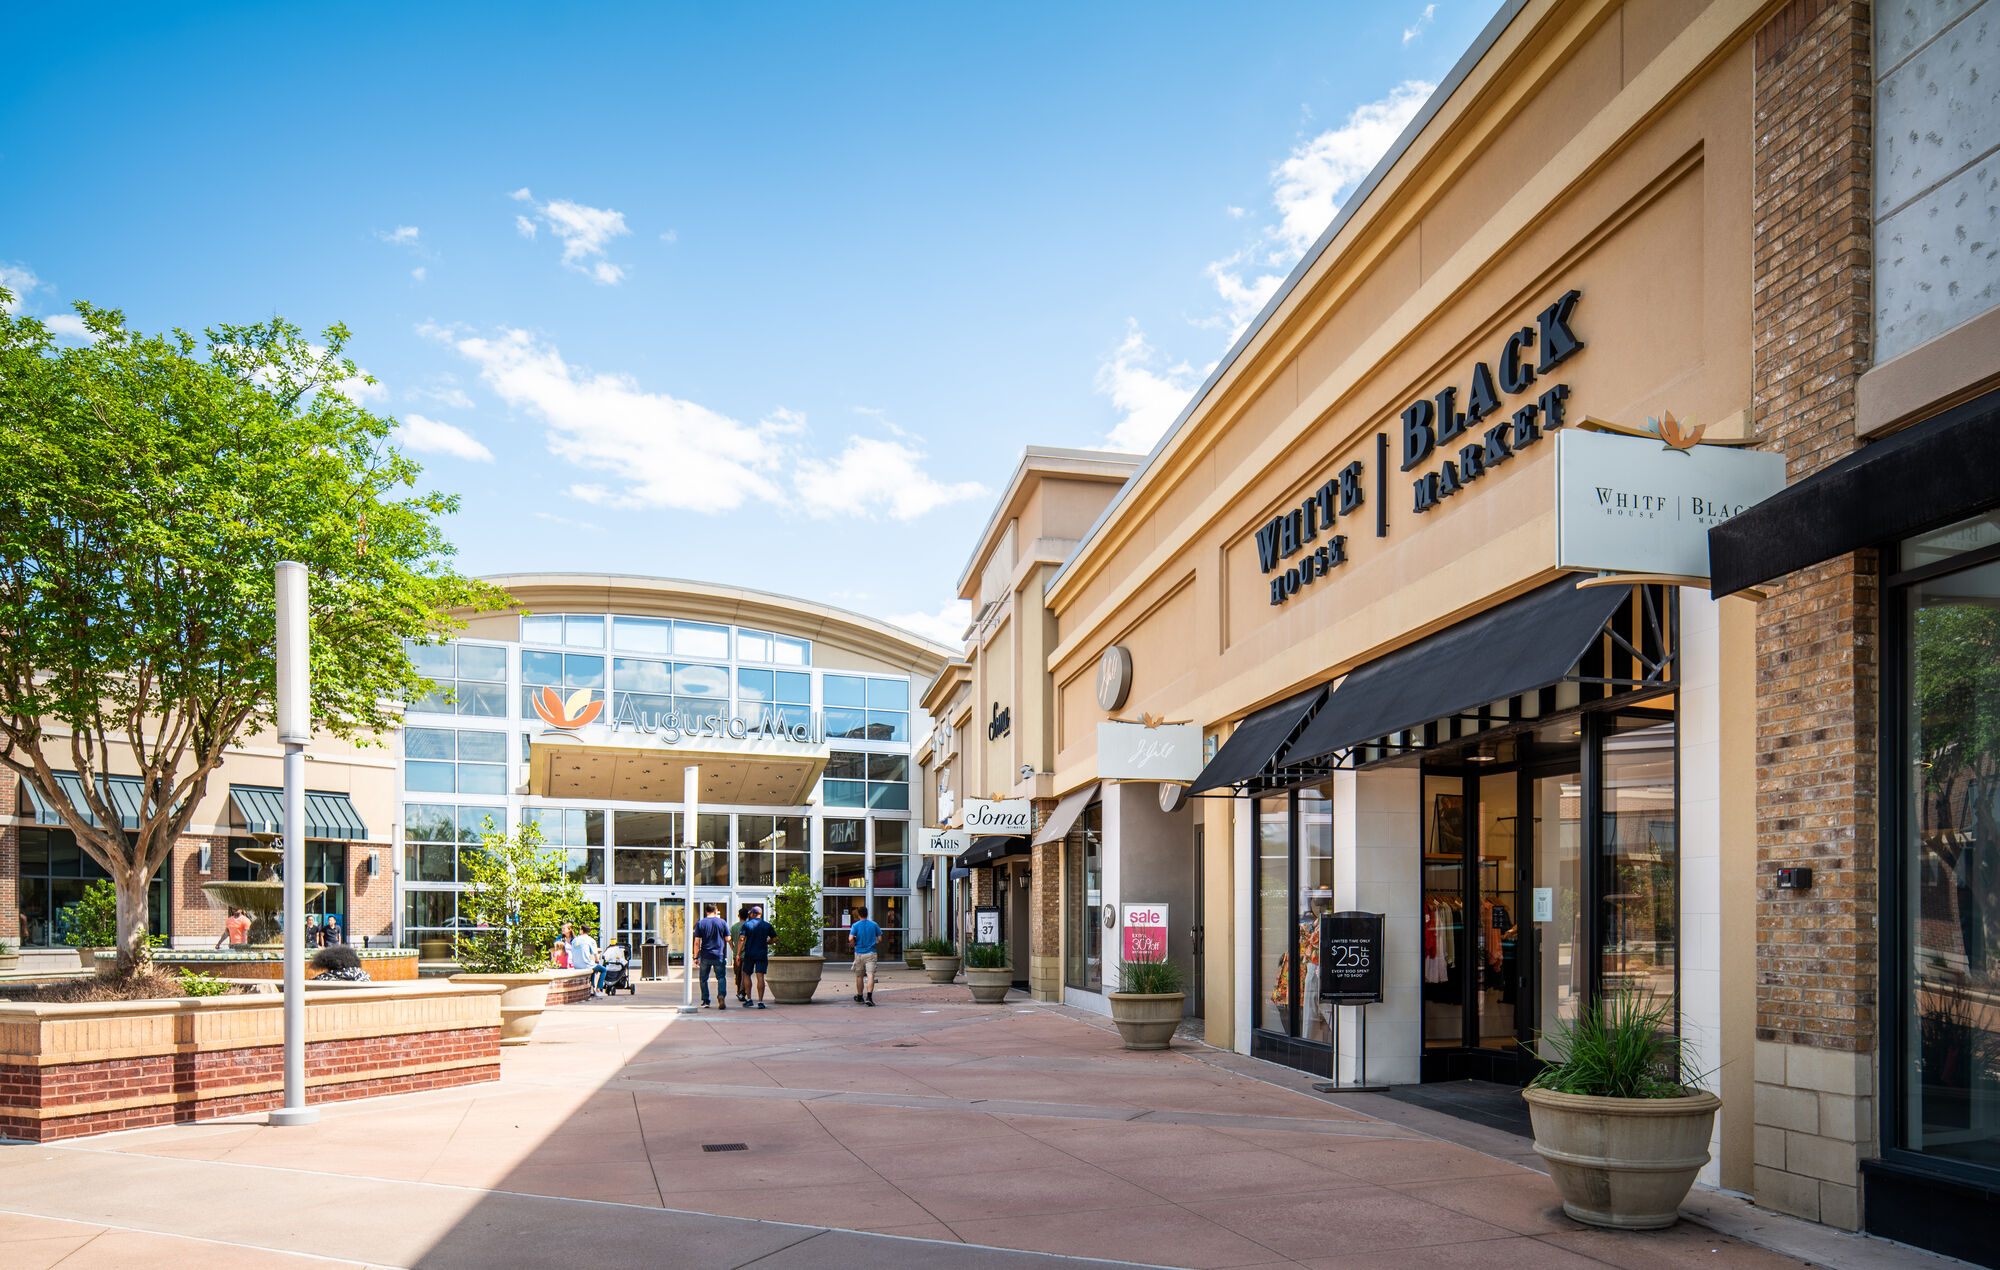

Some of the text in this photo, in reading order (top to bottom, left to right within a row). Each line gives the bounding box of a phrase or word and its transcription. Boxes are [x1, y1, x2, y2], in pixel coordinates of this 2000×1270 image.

[1400, 289, 1585, 472] BLACK
[1413, 384, 1571, 514] MARKET
[1255, 461, 1364, 574] WHITE
[1607, 508, 1654, 519] HOUSE
[1692, 497, 1752, 518] BLAC
[1270, 535, 1348, 606] HOUSE
[613, 692, 827, 745] Augusta Mall
[966, 804, 1028, 825] Soma
[930, 837, 960, 849] PARIS
[1129, 908, 1160, 924] sale
[1331, 945, 1370, 967] $25 OFF
